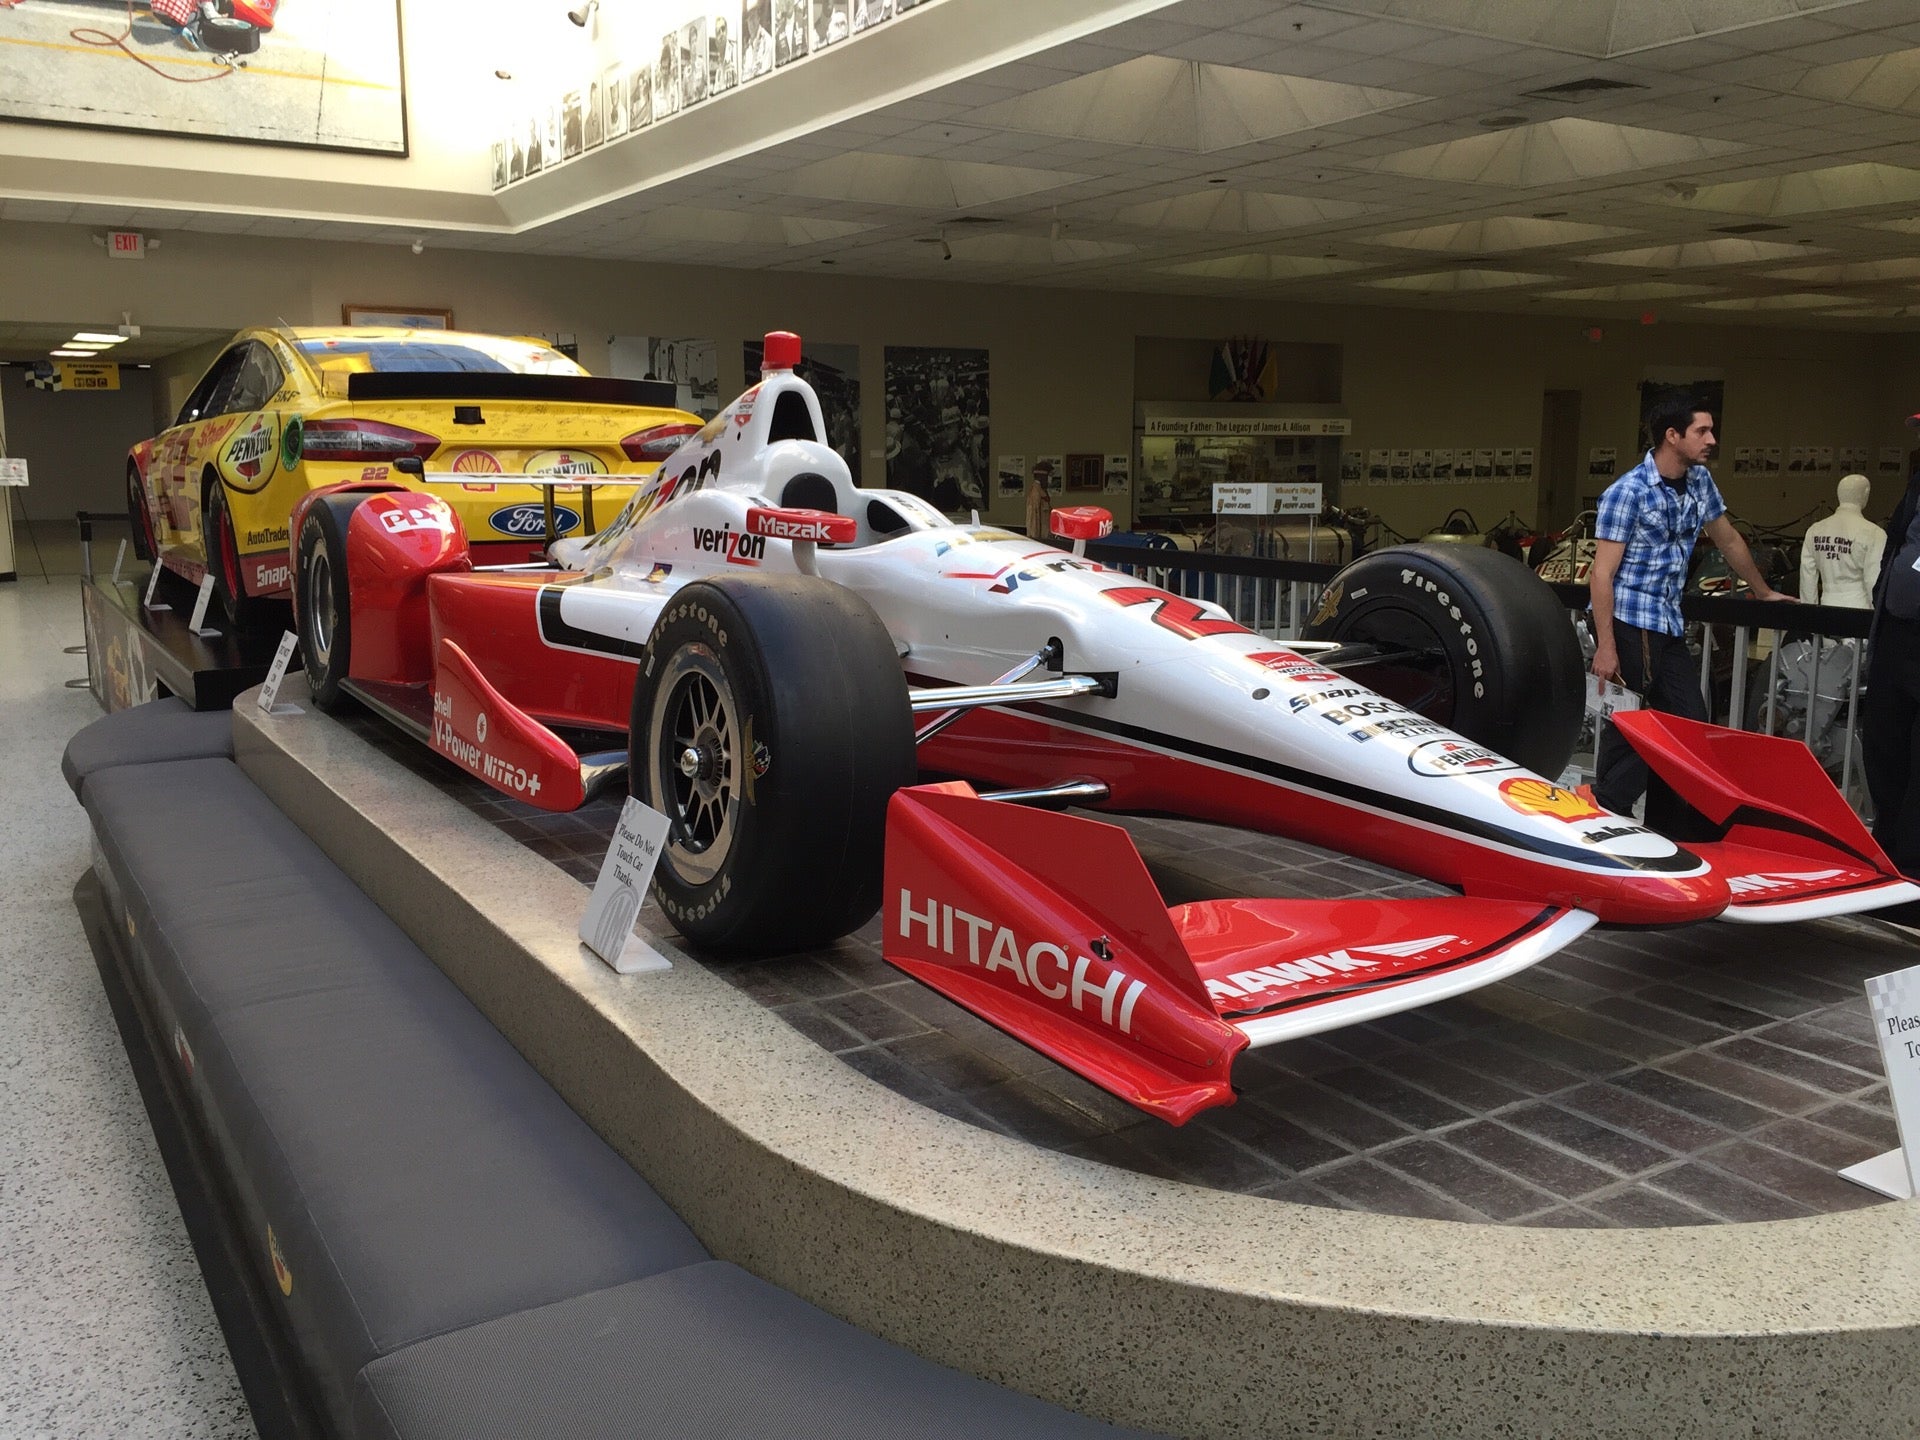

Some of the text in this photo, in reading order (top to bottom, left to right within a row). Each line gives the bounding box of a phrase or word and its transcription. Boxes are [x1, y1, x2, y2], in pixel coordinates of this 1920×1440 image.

[114, 234, 138, 251] EXIT
[274, 390, 300, 403] SKF
[1157, 421, 1188, 434] Founding
[1216, 422, 1227, 432] The
[1228, 422, 1252, 434] Legacy
[1260, 422, 1281, 432] James
[1289, 422, 1311, 432] Allison
[226, 427, 273, 462] PENNZOIL
[361, 466, 389, 481] 22
[758, 515, 832, 540] Mazak
[1814, 536, 1831, 544] BLUE
[693, 523, 767, 567] verizon
[1814, 544, 1836, 552] SPARK
[646, 600, 729, 652] Firestone
[1099, 586, 1260, 640] 2
[1401, 568, 1485, 699] Firestone
[434, 691, 452, 719] Shell
[1289, 688, 1381, 714] Snap-o
[434, 717, 481, 770] V-Power
[618, 823, 655, 857] Please Do Not
[616, 844, 643, 872] Touch Car
[613, 865, 633, 887] Thanks
[898, 887, 1148, 1035] HITACHI
